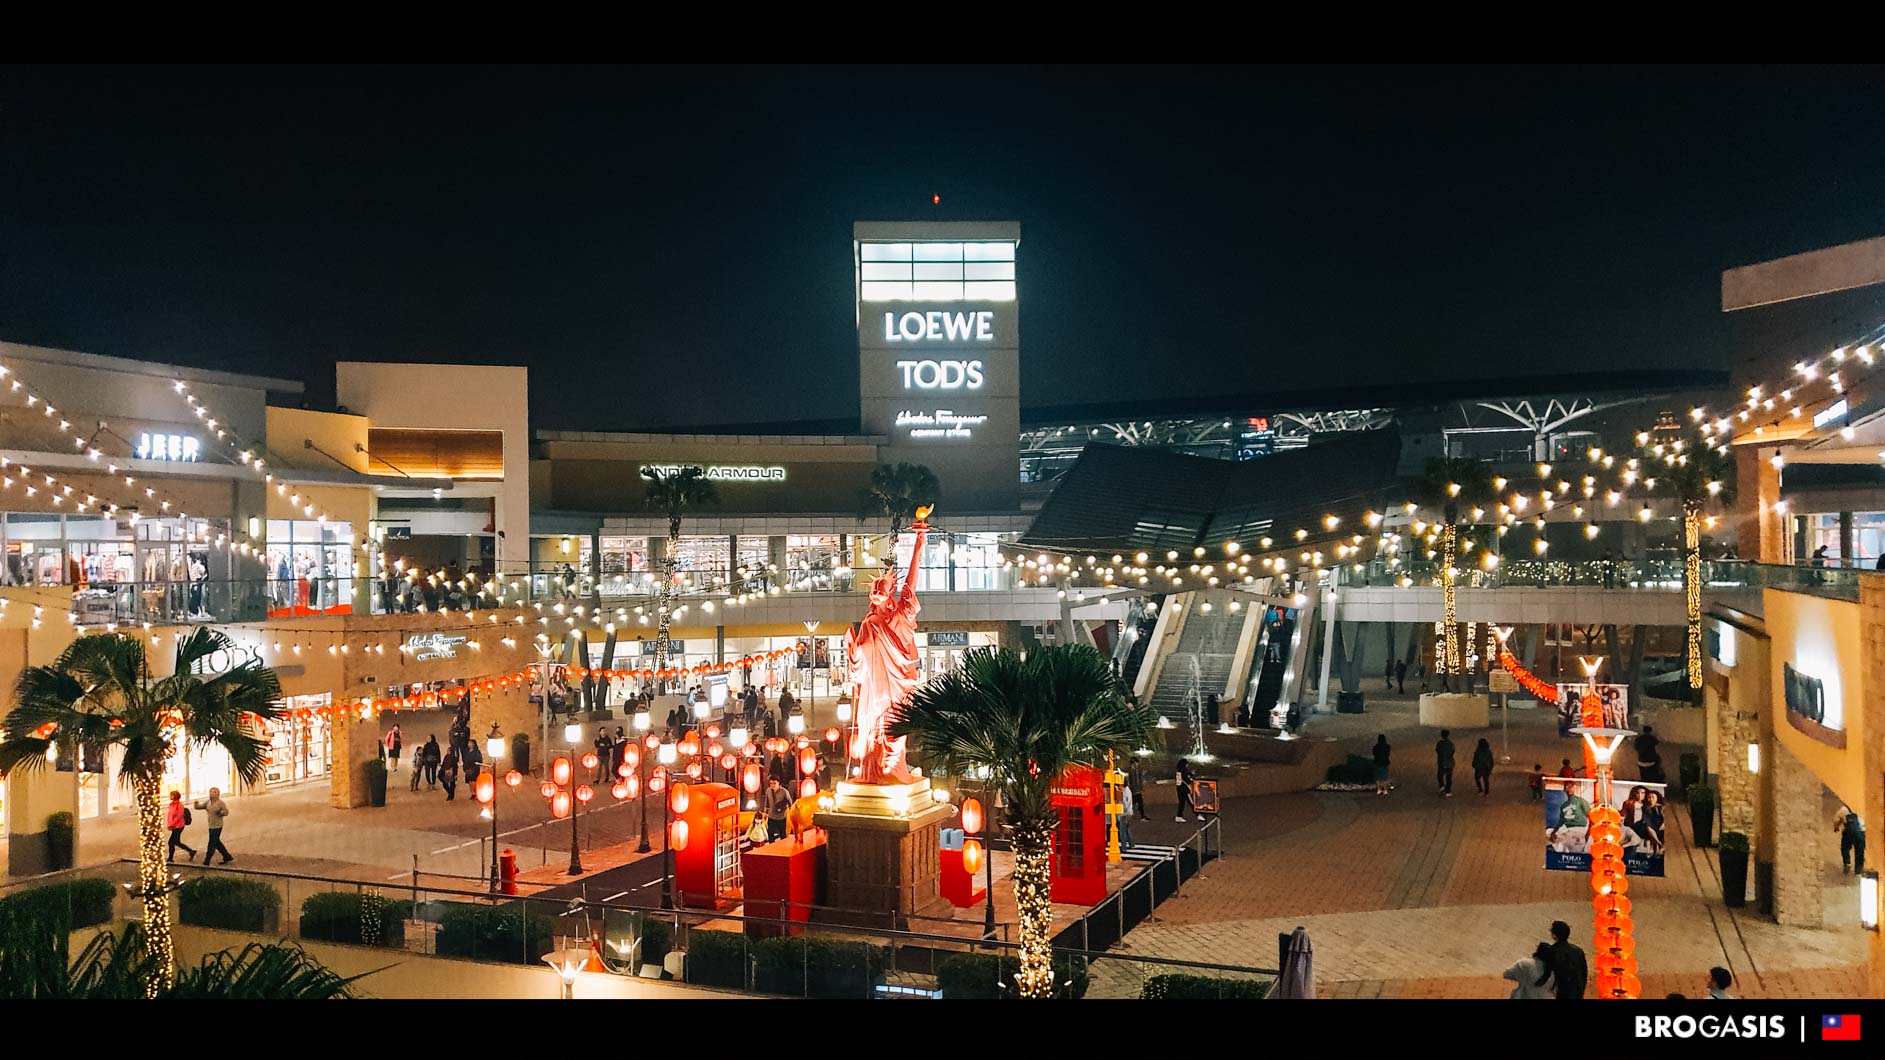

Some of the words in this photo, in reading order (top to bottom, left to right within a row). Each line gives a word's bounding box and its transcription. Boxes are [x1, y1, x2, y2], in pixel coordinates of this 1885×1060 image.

[885, 311, 993, 341] LOEWE
[896, 360, 984, 389] TOD'S
[707, 466, 785, 480] ARMOUR
[931, 632, 965, 643] ARMANI
[645, 640, 681, 651] ARNI
[1561, 854, 1582, 862] POLO
